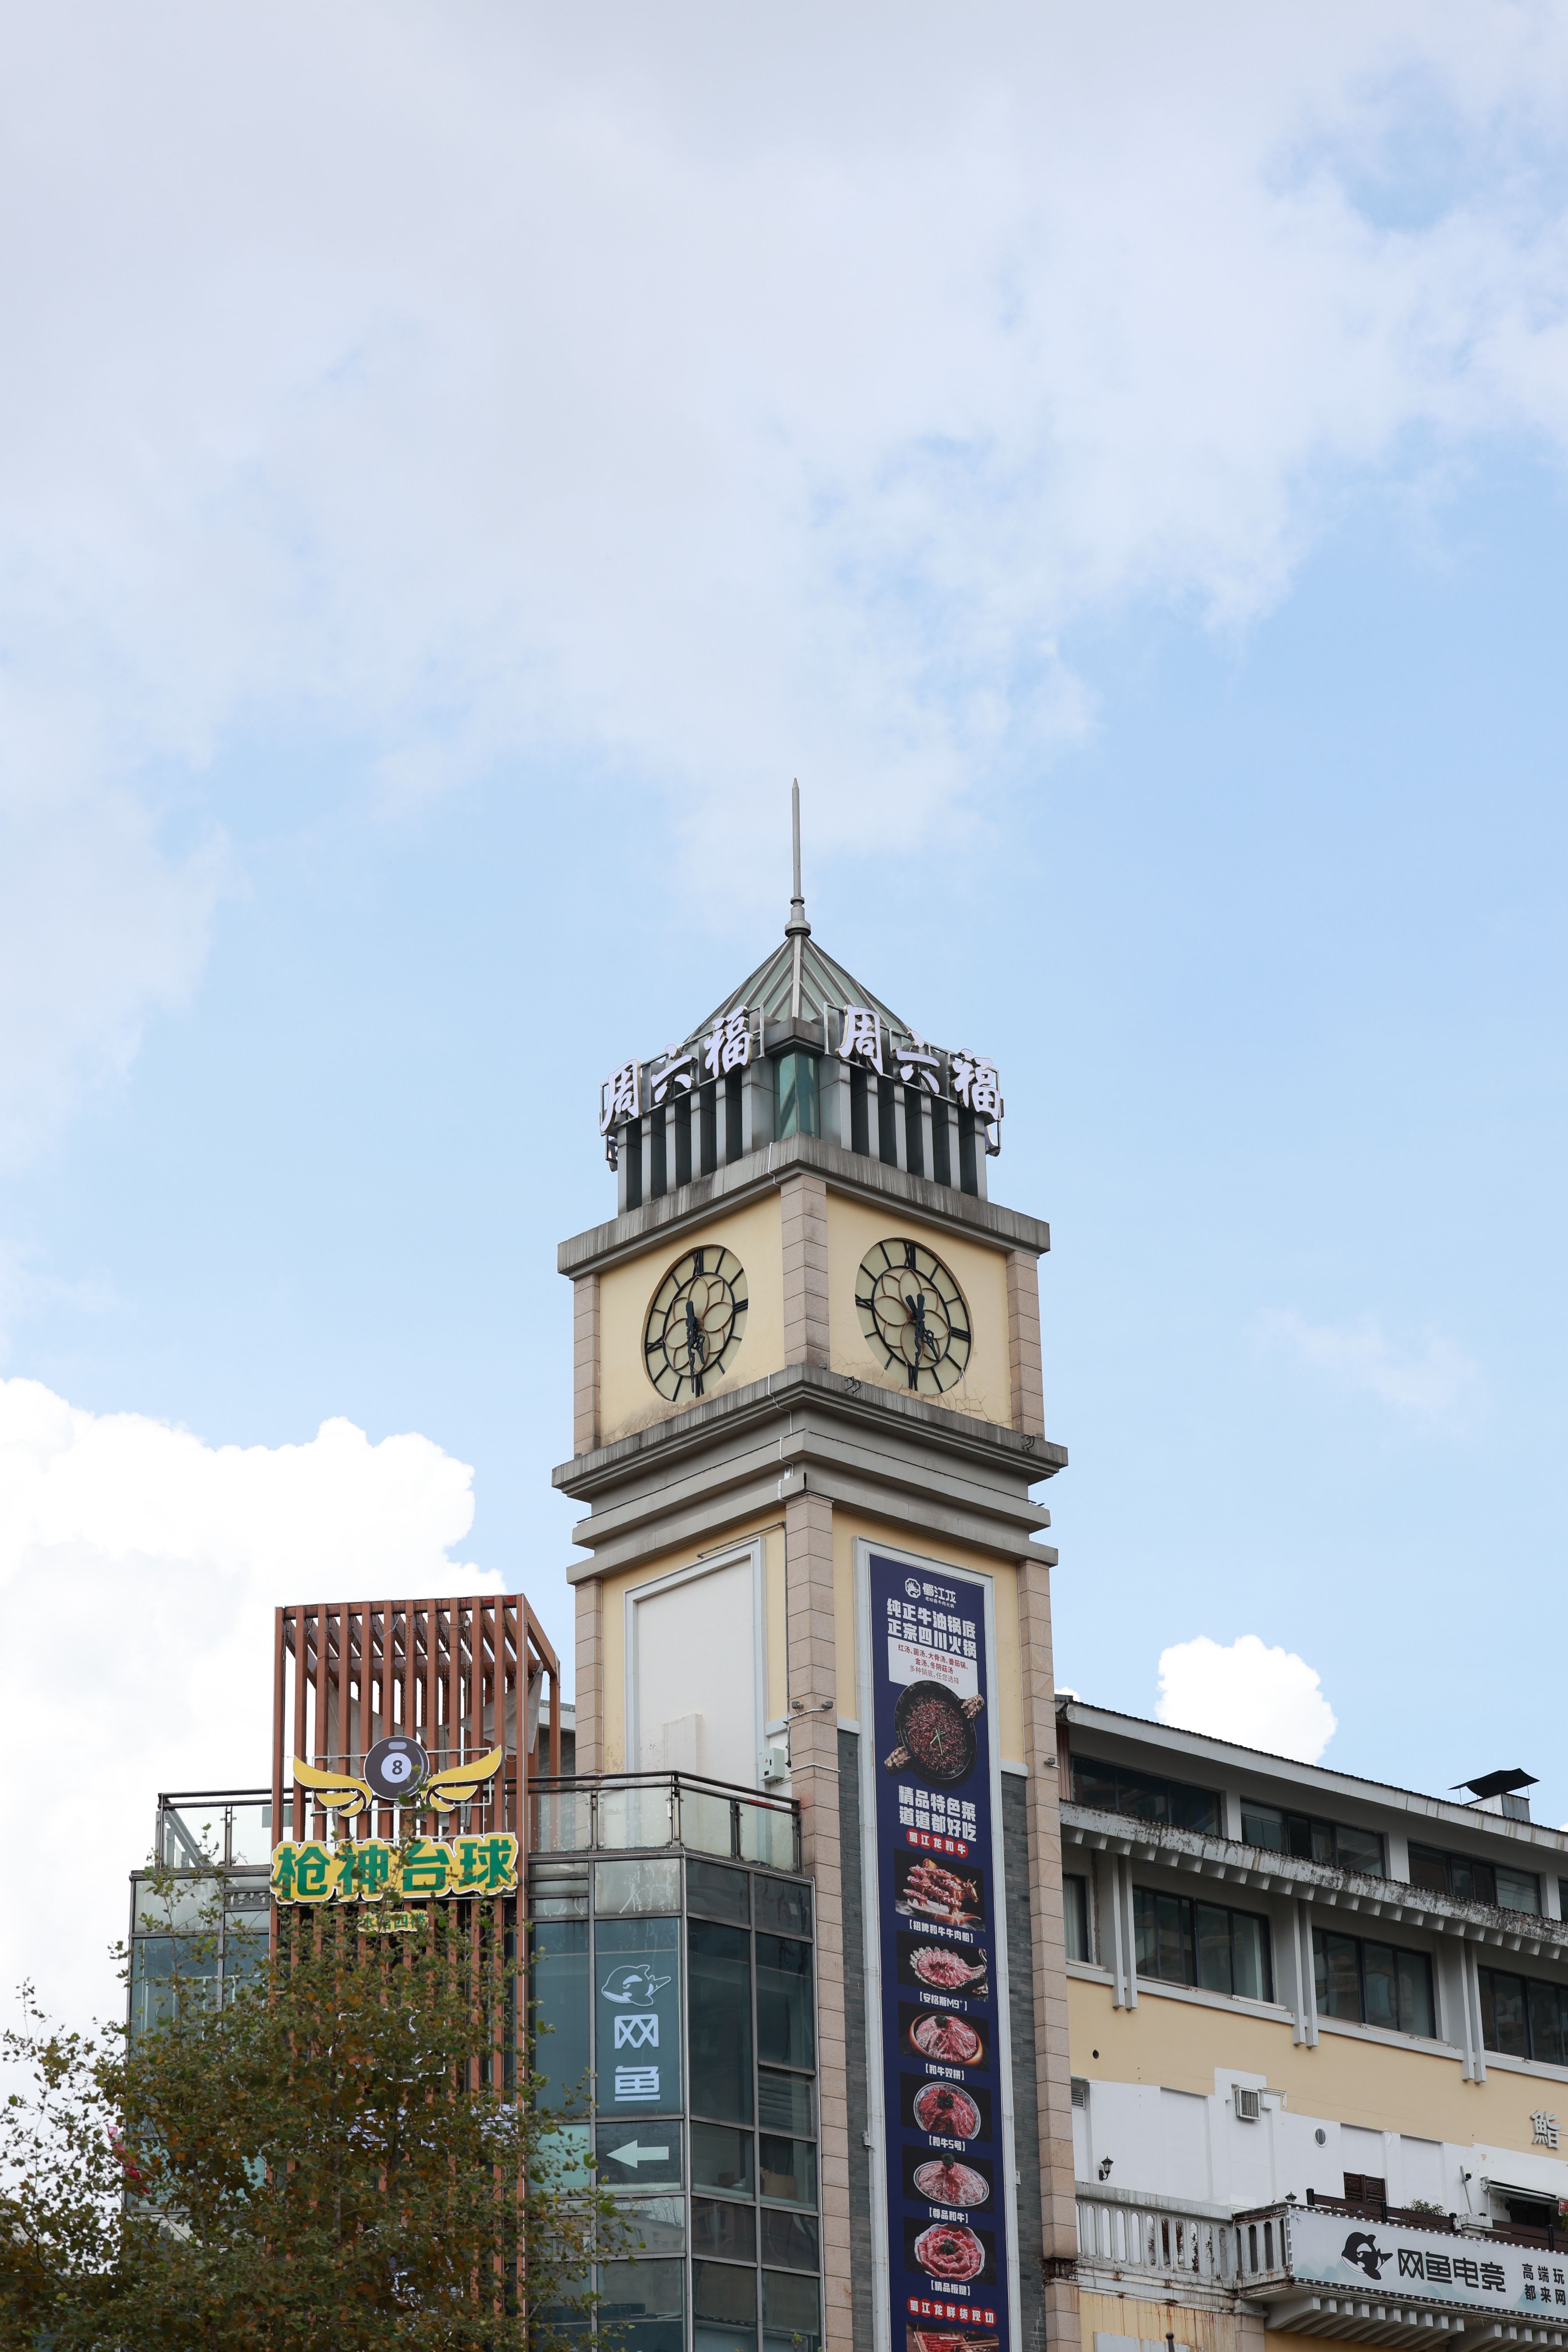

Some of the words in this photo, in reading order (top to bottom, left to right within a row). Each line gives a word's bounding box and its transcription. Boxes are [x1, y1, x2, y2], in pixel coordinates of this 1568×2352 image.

[600, 1004, 754, 1133] 周六福
[835, 1004, 1001, 1122] 周六福
[923, 1583, 956, 1604] 蜀江龙
[887, 1598, 976, 1639] 纯正牛油锅底
[888, 1618, 977, 1659] 正宗四川火锅
[915, 1658, 953, 1674] 金汤、冬阴菇汤
[391, 1760, 403, 1776] 8
[898, 1785, 976, 1822] 精品特色菜
[899, 1806, 977, 1842] 道道都好吃
[909, 1831, 966, 1855] 蜀江龙和牛
[277, 1838, 512, 1898] 枪神台球
[614, 2014, 661, 2102] 网鱼
[1397, 2248, 1506, 2292] 网鱼电竞
[1522, 2263, 1564, 2285] 高端玩
[910, 2300, 994, 2323] 蜀江龙鲜货现切
[1524, 2283, 1566, 2305] 都来网
